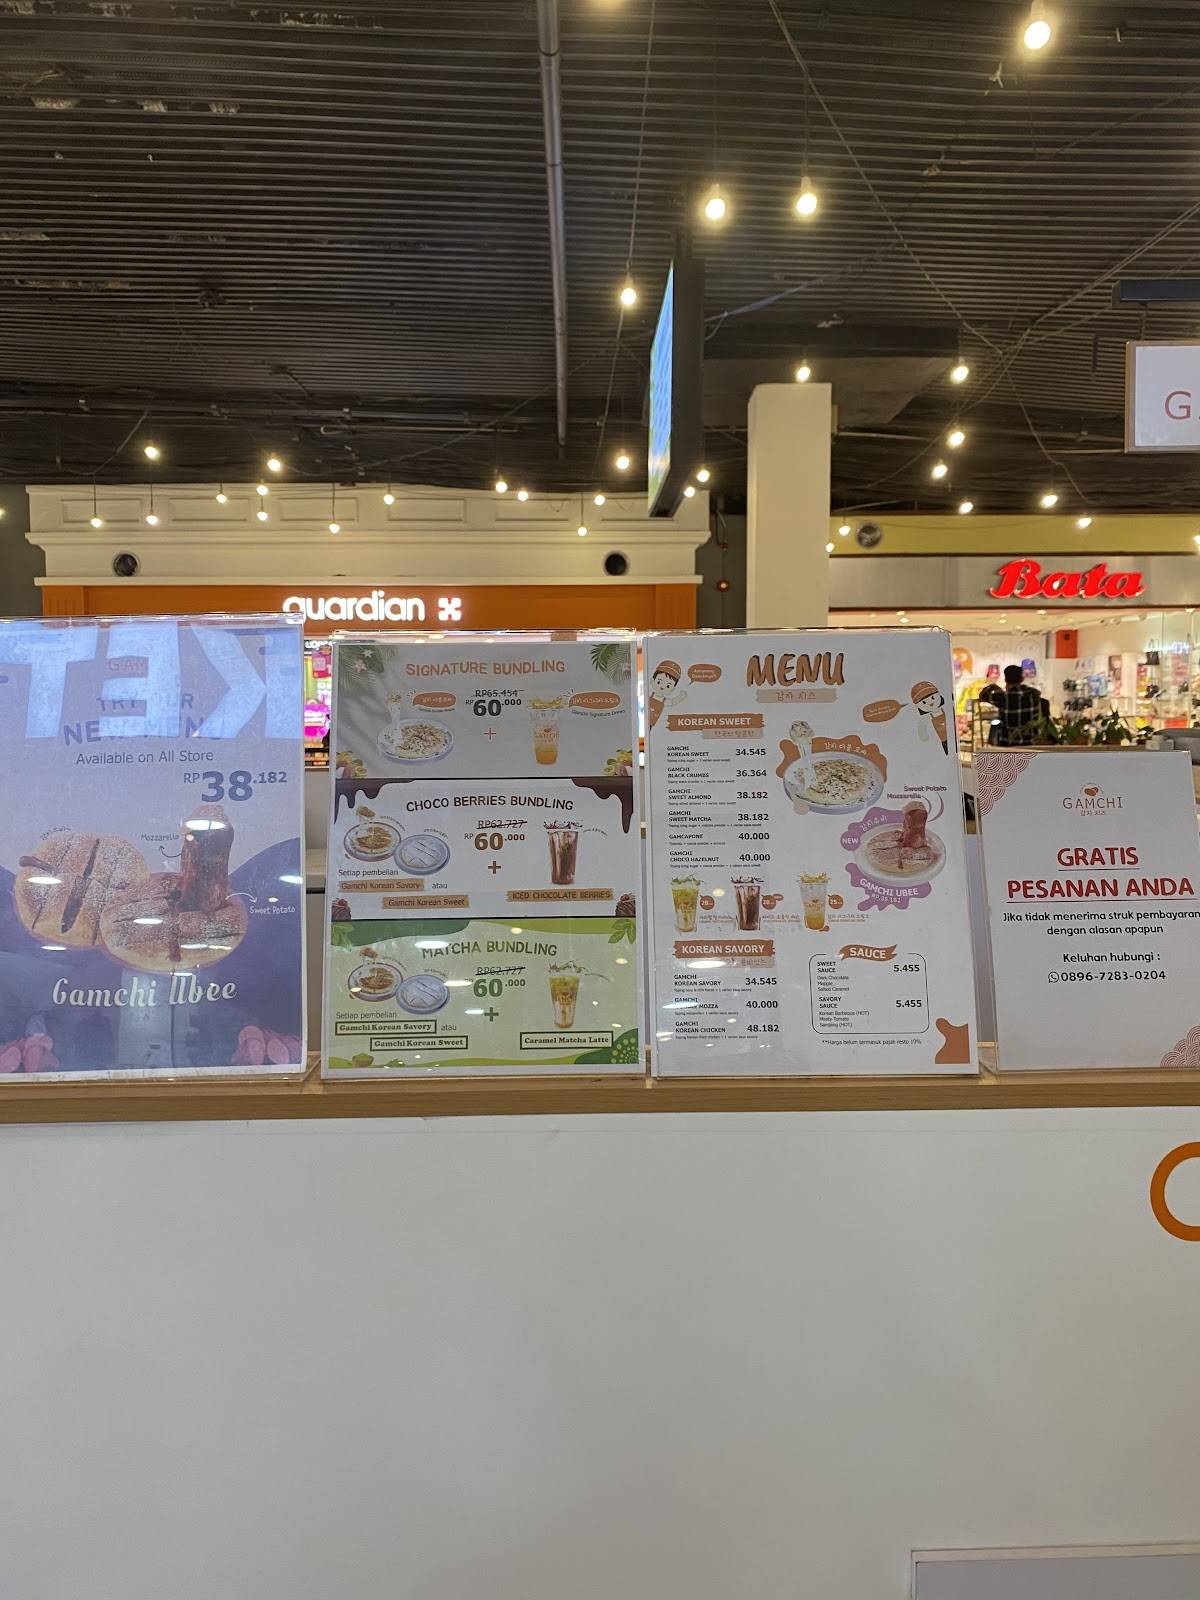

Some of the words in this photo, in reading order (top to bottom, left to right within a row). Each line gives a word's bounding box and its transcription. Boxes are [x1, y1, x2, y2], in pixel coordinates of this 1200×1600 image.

[1165, 391, 1200, 420] G
[989, 558, 1147, 599] Bata
[282, 590, 426, 624] guardian
[405, 661, 488, 677] SIGNATURE
[492, 660, 566, 675] BUNDLING
[747, 652, 845, 687] MENU
[677, 718, 717, 727] KOREAN
[719, 717, 752, 726] SWEET
[735, 748, 766, 756] 34.545
[76, 752, 133, 765] Available
[138, 753, 154, 763] on
[158, 751, 175, 762] All
[179, 750, 214, 762] Store
[736, 769, 767, 777] 36.364
[736, 791, 768, 799] 38.182
[406, 798, 449, 812] CHOCO
[453, 795, 506, 807] BERRIES
[510, 796, 574, 811] BUNDLING
[1062, 796, 1124, 809] GAMCHI
[737, 813, 769, 821] 38.182
[477, 819, 525, 829] RP62.727
[141, 833, 180, 842] Mozzarella
[738, 832, 770, 840] 40.000
[739, 853, 771, 861] 40.000
[1056, 846, 1139, 867] GRATIS
[338, 869, 361, 877] Setiap
[362, 868, 399, 877] pembelian
[341, 882, 368, 890] Gamchi
[396, 881, 420, 890] Savory
[860, 878, 894, 897] GAMCHI
[895, 887, 919, 897] UBEE
[1007, 878, 1119, 899] PESANAN
[1125, 877, 1195, 897] ANDA
[512, 890, 530, 900] ICED
[532, 890, 577, 900] CHOCOLATE
[580, 889, 612, 899] BERRIES
[443, 898, 465, 906] Sweet
[249, 905, 271, 914] Sweet
[272, 905, 296, 914] Potato
[1003, 912, 1022, 922] Jika
[1025, 911, 1051, 921] tidak
[1053, 911, 1106, 921] menerima
[1108, 910, 1134, 920] struk
[1136, 910, 1200, 922] pembayaran
[1046, 926, 1086, 937] dengan
[1088, 925, 1122, 935] alasan
[1124, 925, 1163, 936] apapun
[422, 942, 481, 958] MATCHA
[486, 941, 557, 956] BUNDLING
[681, 945, 723, 954] KOREAN
[724, 944, 765, 954] SAVORY
[849, 947, 886, 959] SAUCE
[1063, 953, 1108, 963] Keluhan
[1110, 951, 1154, 963] hubungi
[476, 966, 523, 976] RP62.727
[893, 964, 920, 972] 5.455
[1060, 970, 1167, 982] 0896-7283-0204
[745, 977, 777, 986] 34.545
[52, 977, 158, 1007] Gamchi
[168, 973, 238, 1005] Ubee
[746, 1000, 778, 1009] 40.000
[895, 999, 922, 1008] 5.455
[335, 1011, 359, 1020] Setiap
[360, 1011, 397, 1020] pembelian
[339, 1024, 371, 1032] Gamchi
[403, 1023, 432, 1031] Savory
[747, 1024, 780, 1033] 48.182
[524, 1037, 557, 1045] Caramel
[588, 1036, 610, 1044] Latte
